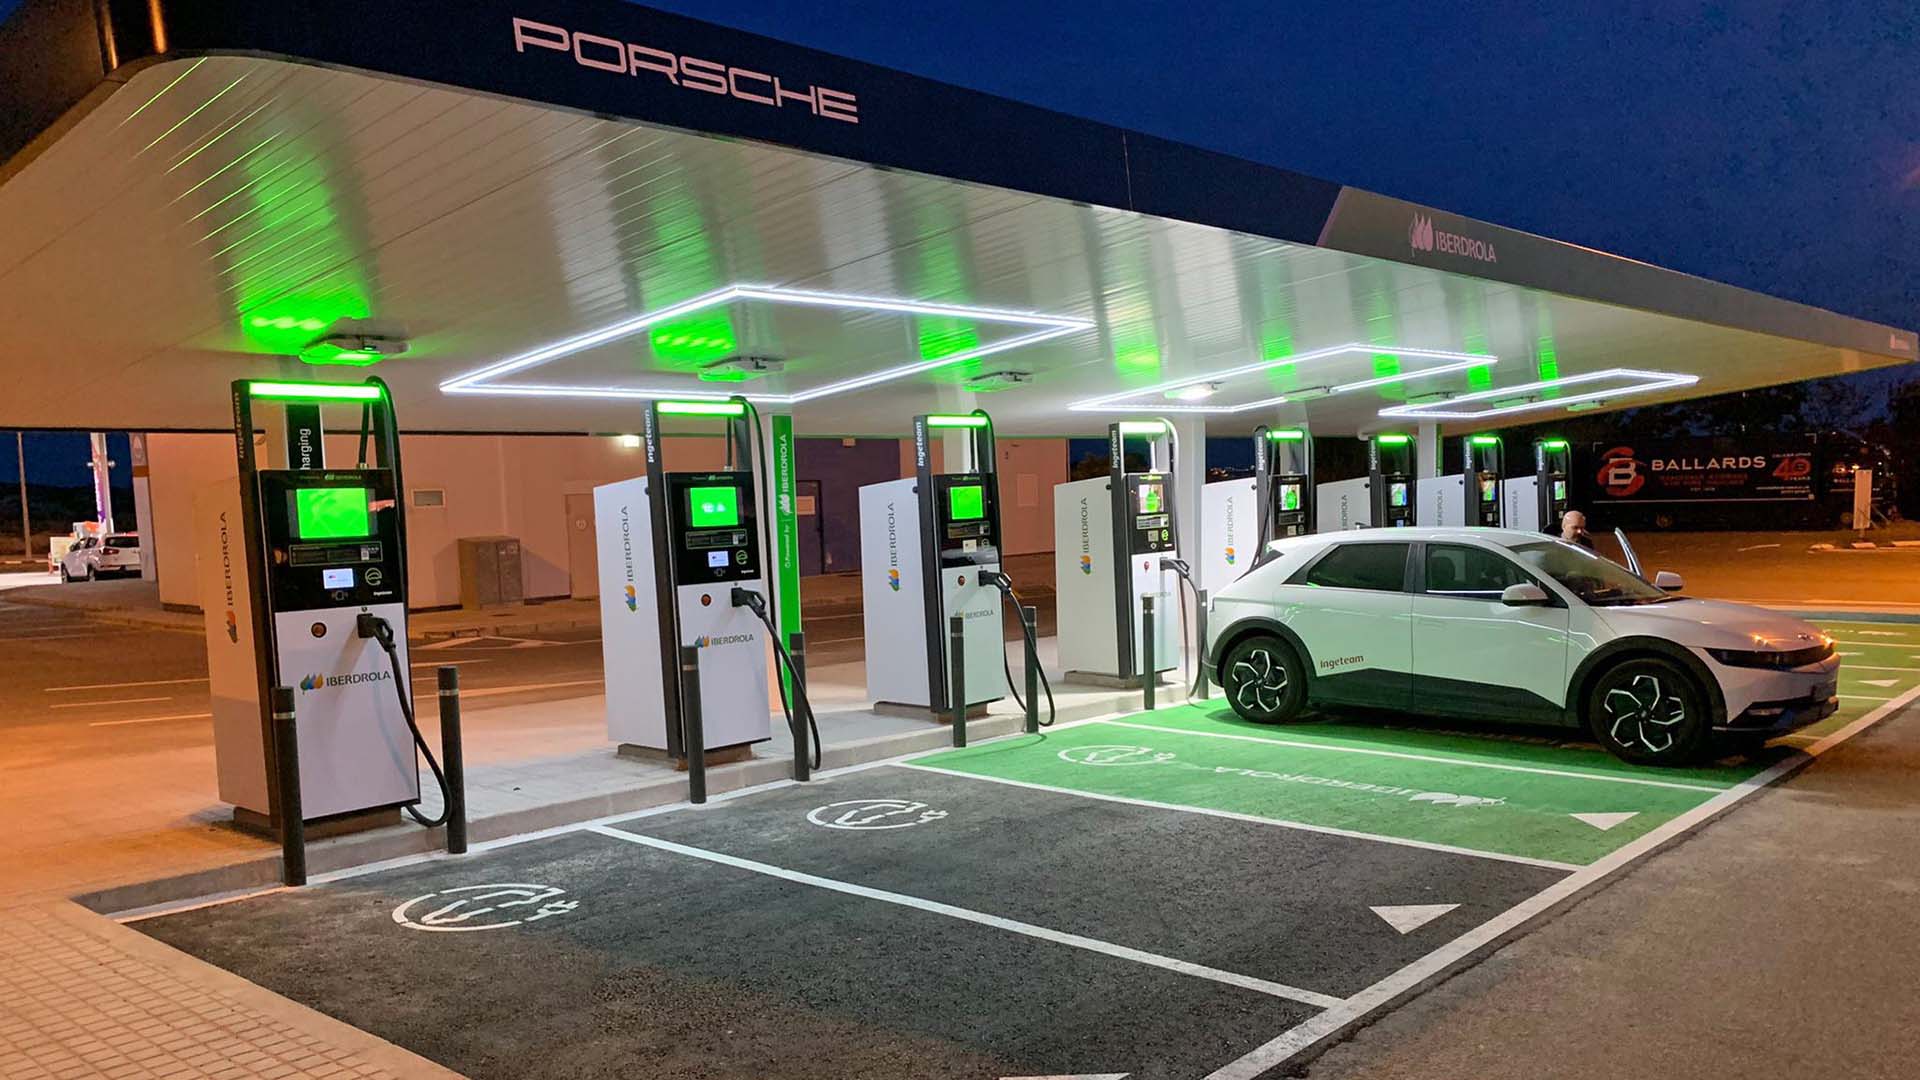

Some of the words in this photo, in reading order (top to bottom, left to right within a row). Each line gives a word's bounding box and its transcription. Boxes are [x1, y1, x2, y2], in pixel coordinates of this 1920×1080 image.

[513, 17, 859, 124] PORSCHE
[1435, 230, 1497, 263] IBERDROLA
[298, 428, 312, 471] harging
[780, 433, 790, 493] IBERDROLA
[1651, 456, 1767, 472] BALLARDS
[621, 505, 634, 583] IBERDROLA
[888, 502, 898, 567] IBERDROLA
[1080, 497, 1090, 554] IBERDROLA
[220, 511, 234, 607] IBERDROLA
[711, 633, 754, 646] IBERDROLA
[326, 670, 391, 687] IBERDROLA
